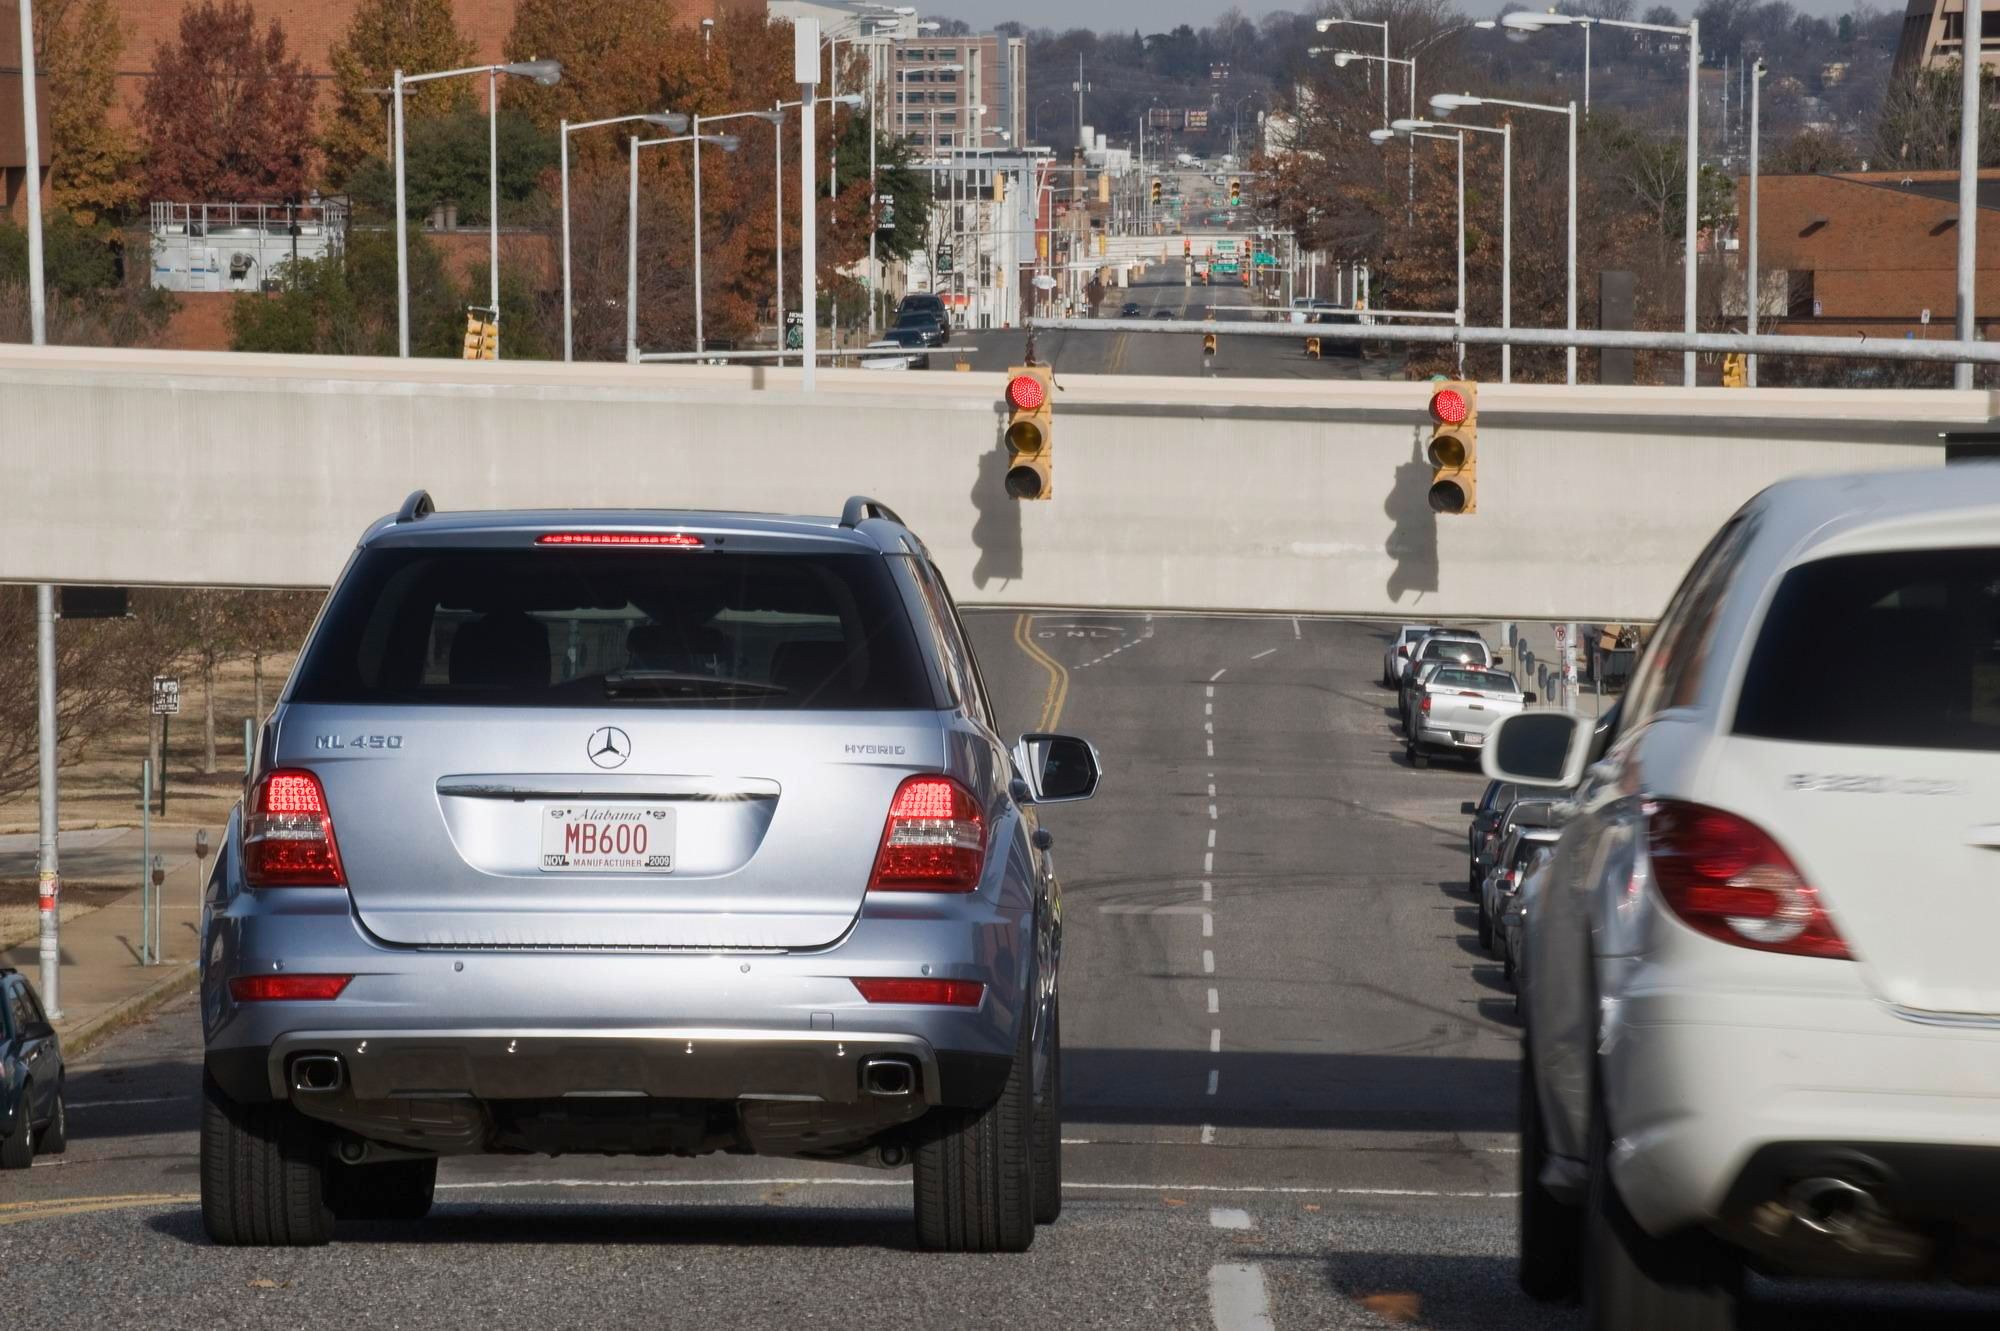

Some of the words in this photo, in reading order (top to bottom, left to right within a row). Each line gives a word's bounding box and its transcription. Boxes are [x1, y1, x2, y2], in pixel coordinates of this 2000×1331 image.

[315, 735, 344, 749] ML
[350, 735, 404, 749] 450
[845, 743, 906, 755] HYBRID
[574, 808, 642, 821] Alabama
[565, 823, 648, 854] MB600
[573, 858, 642, 867] MANUFACTURER
[649, 856, 670, 867] 2009
